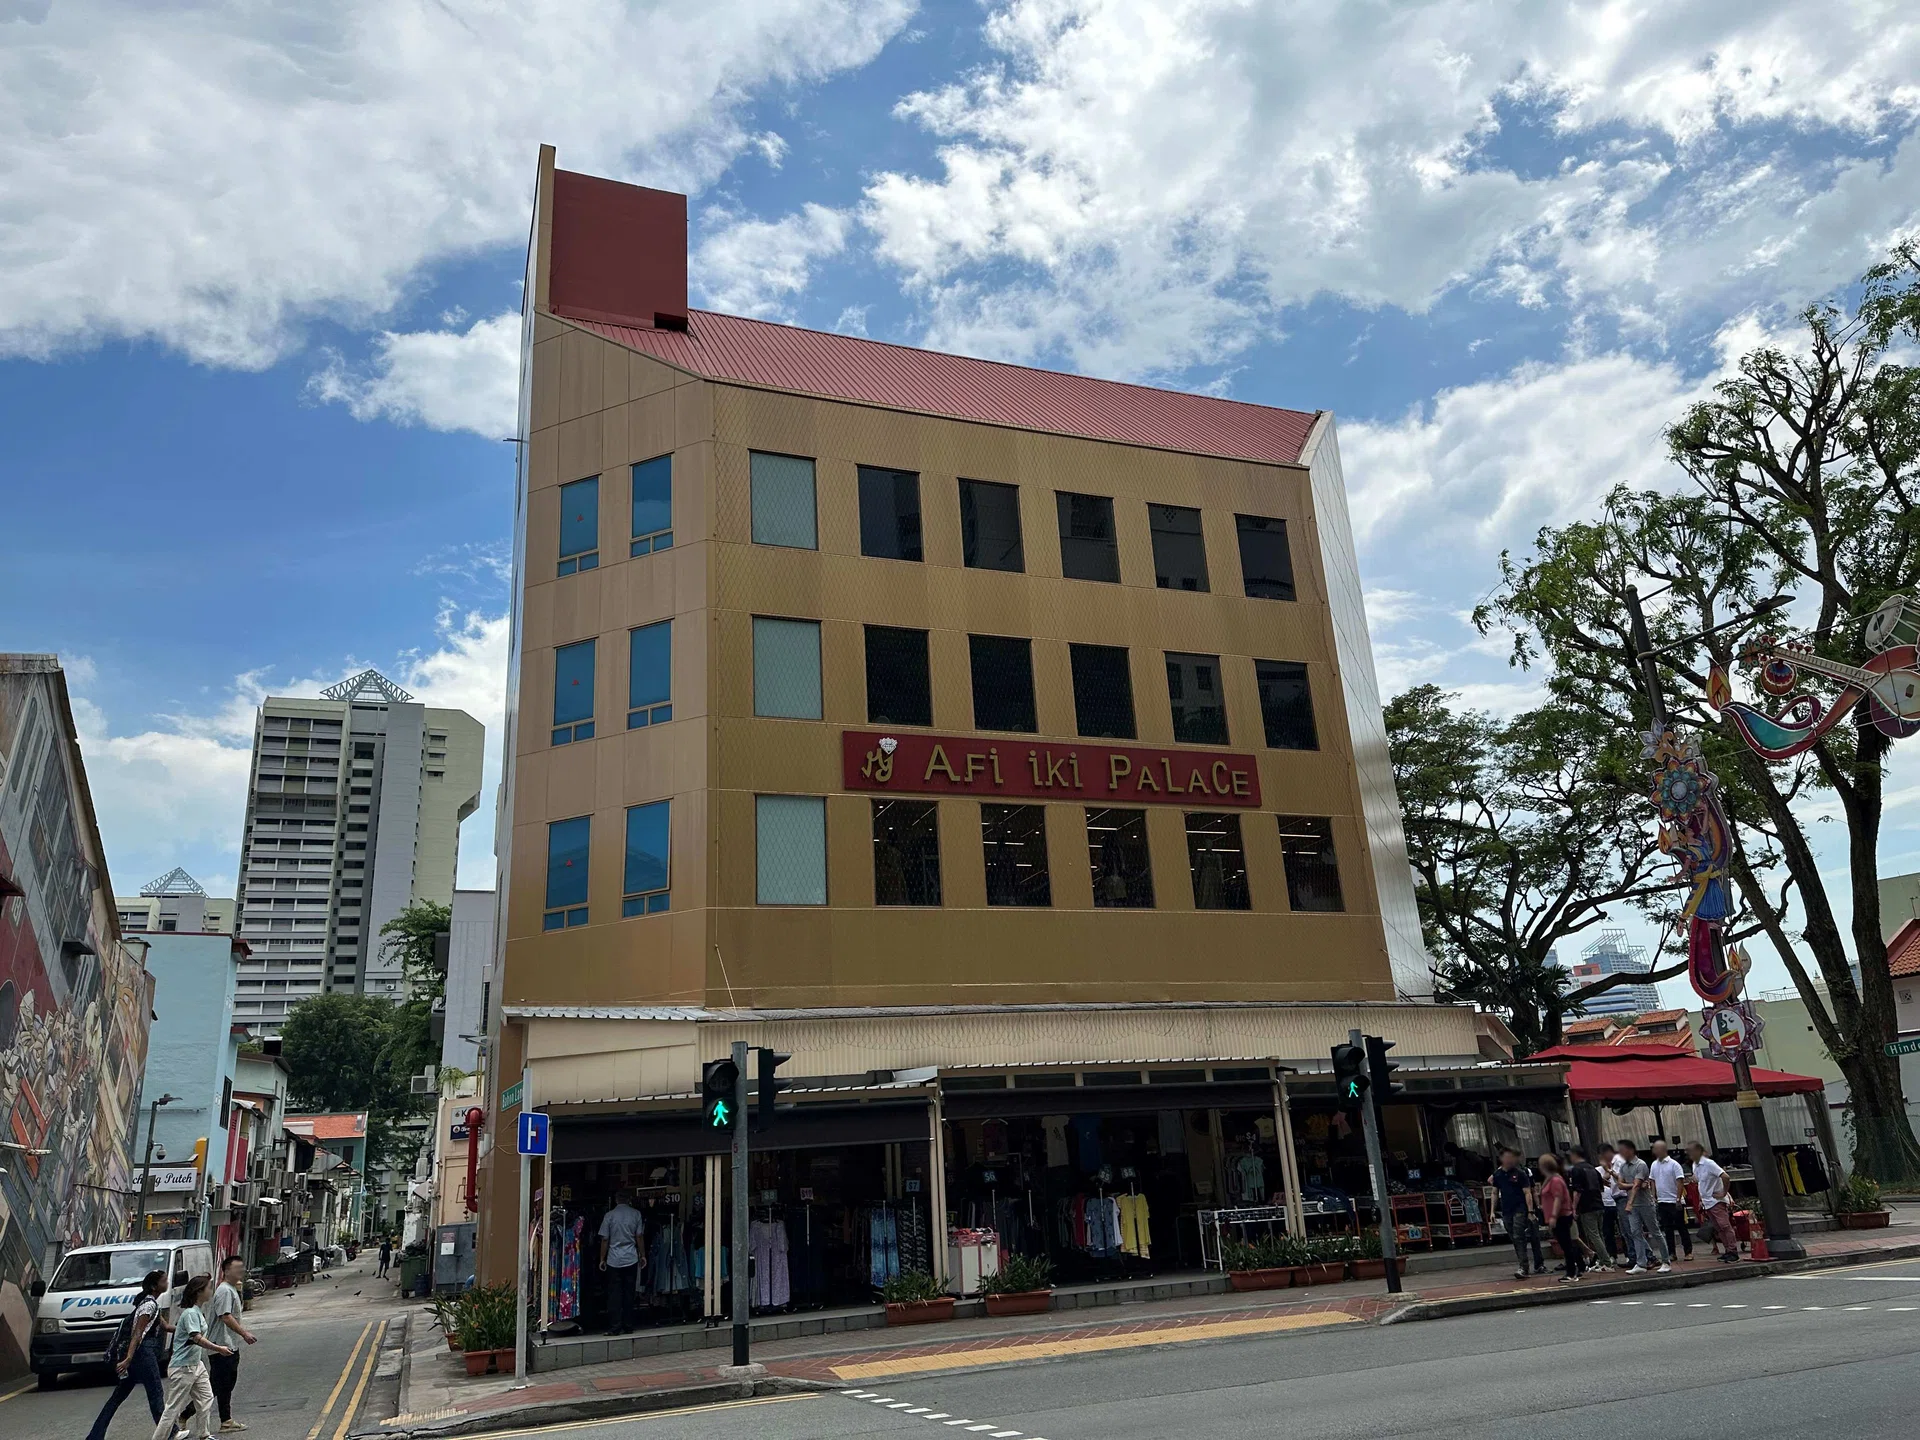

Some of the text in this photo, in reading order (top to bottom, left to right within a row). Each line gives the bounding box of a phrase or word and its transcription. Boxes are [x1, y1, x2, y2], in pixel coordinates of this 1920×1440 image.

[1109, 754, 1251, 796] PALACE
[164, 1172, 192, 1184] Puteh
[908, 1181, 918, 1190] $7
[664, 1193, 681, 1204] $10
